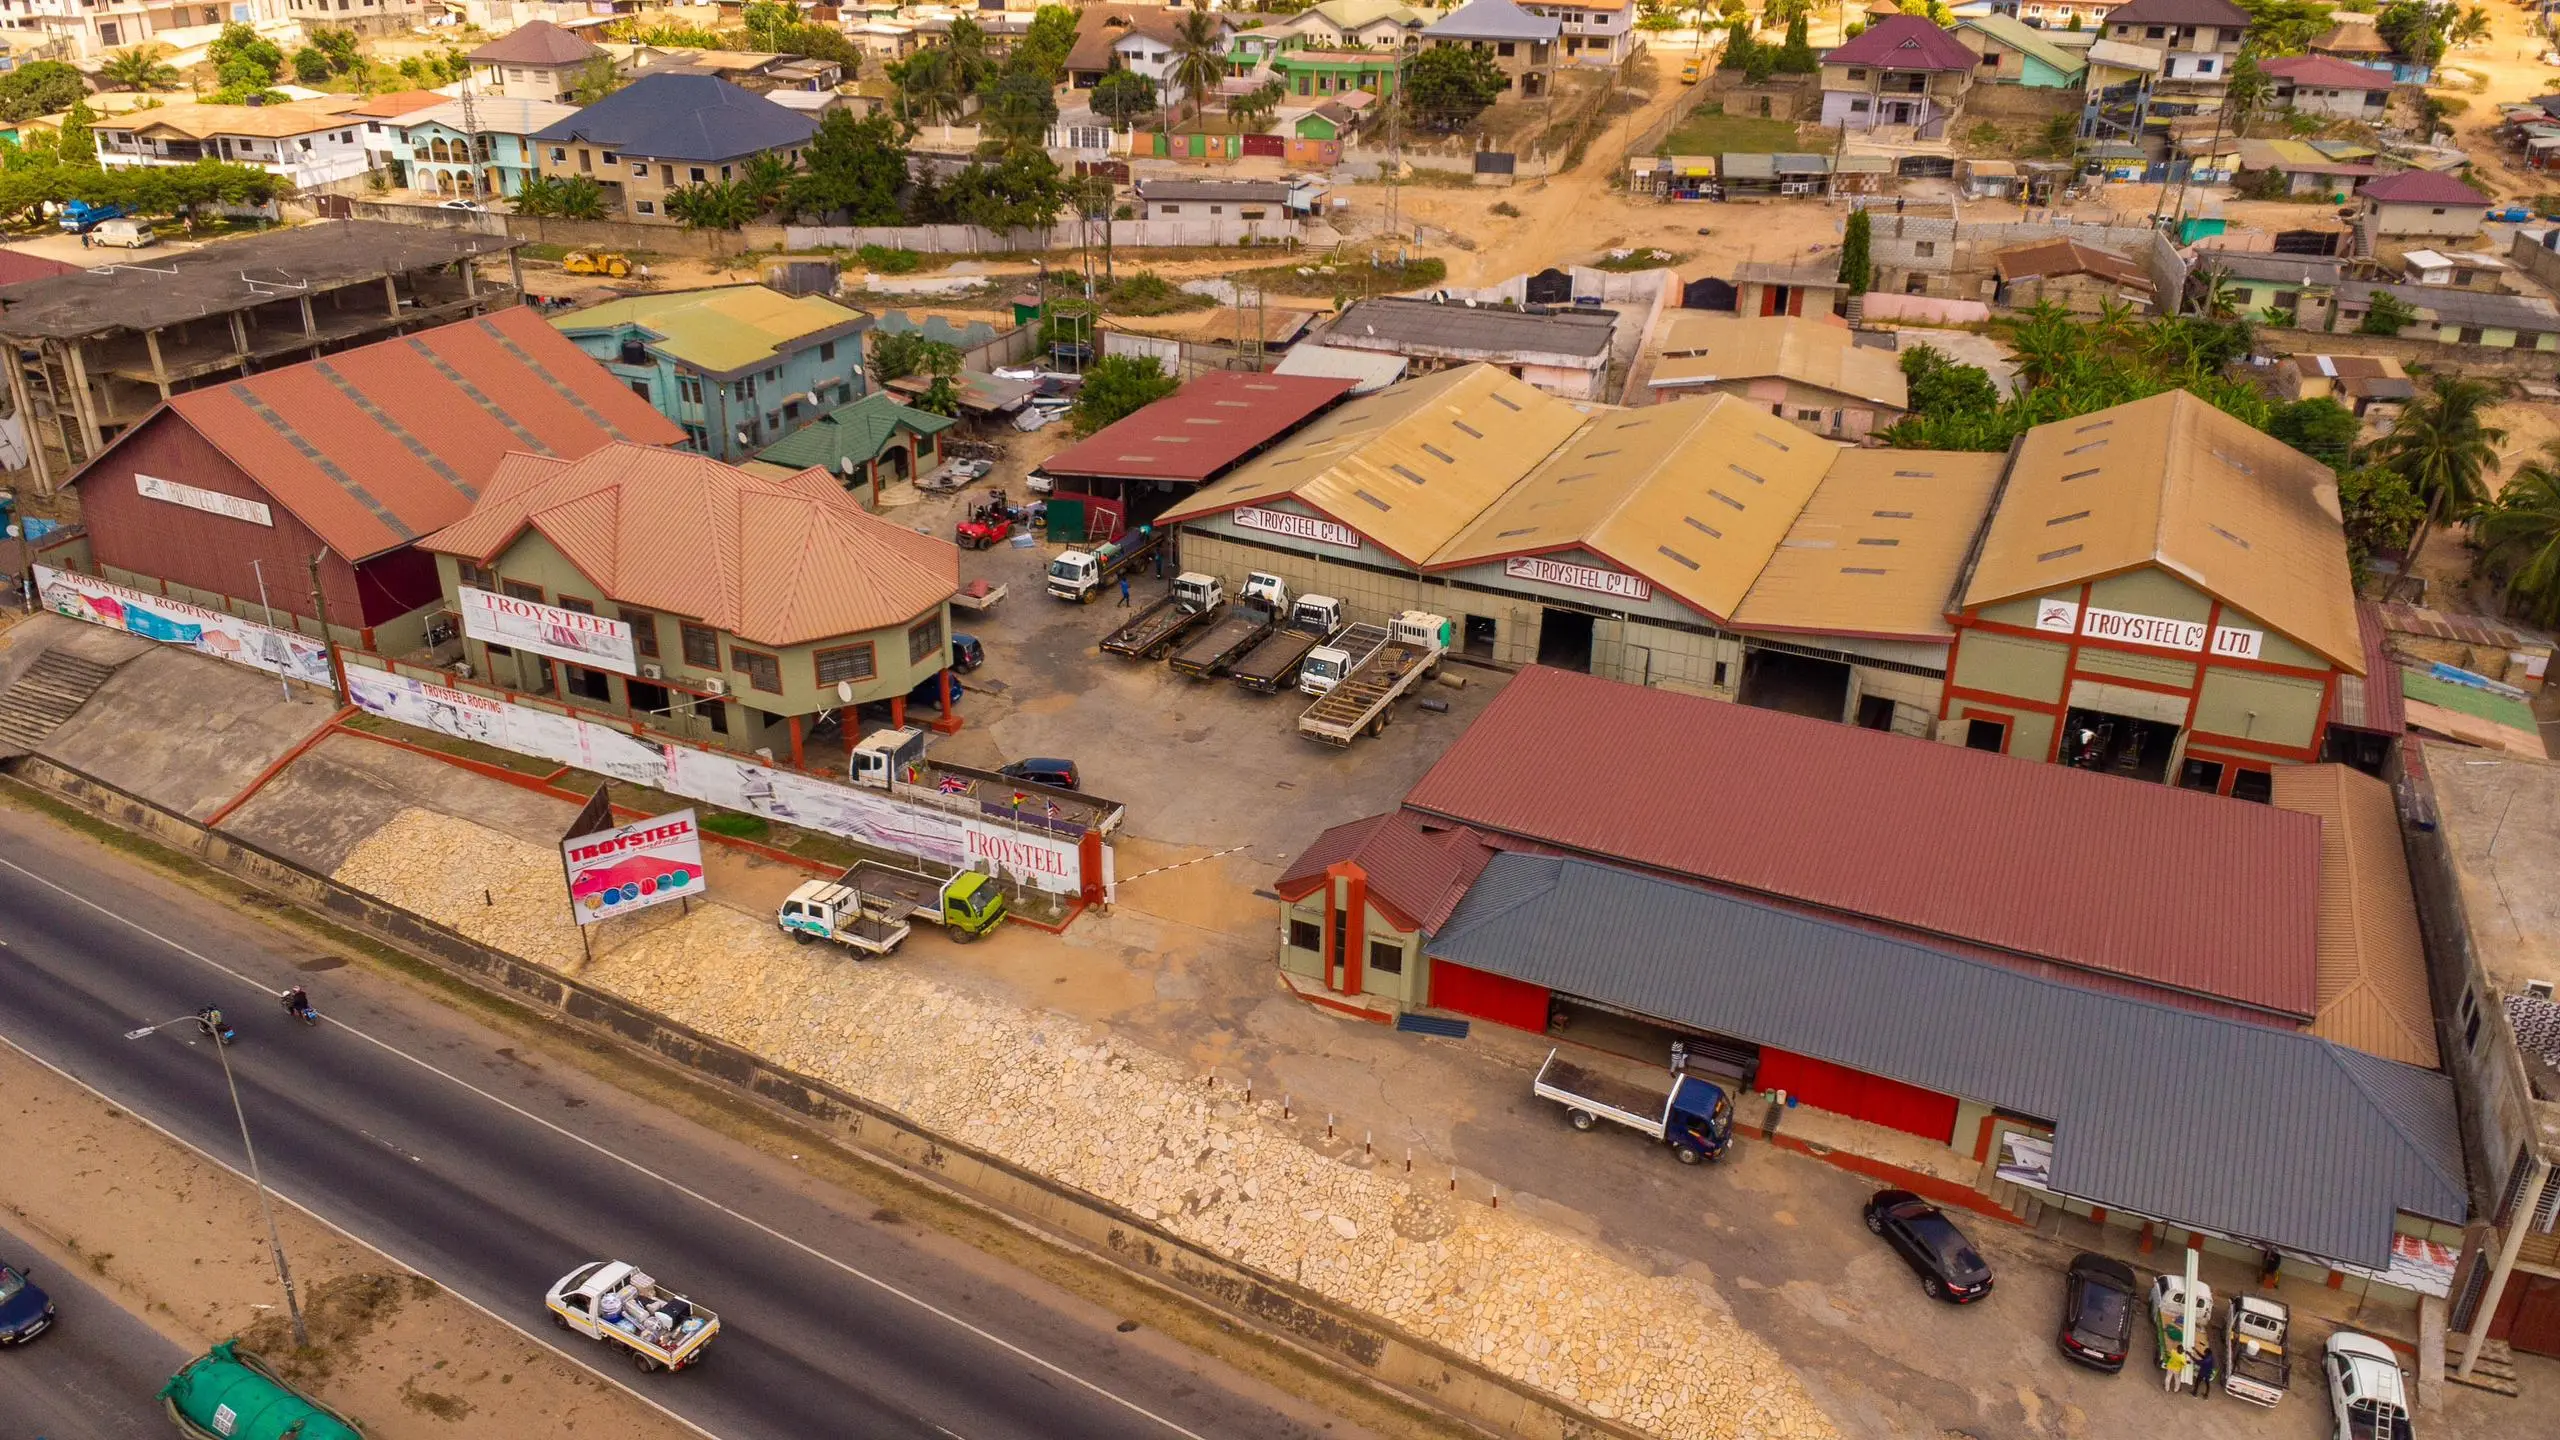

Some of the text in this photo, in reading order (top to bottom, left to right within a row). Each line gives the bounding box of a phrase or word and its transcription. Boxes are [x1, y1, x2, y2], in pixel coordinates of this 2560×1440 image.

[1259, 510, 1317, 537] TROYSTEEL
[1535, 560, 1602, 588] TROYSTEEL
[63, 572, 223, 623] TROYSTEEL ROOFING
[481, 593, 625, 640] TROYSTEEL
[2088, 611, 2181, 645] TROYSTEEL
[2217, 630, 2251, 654] LTD.
[423, 684, 501, 714] TROYSTEEL ROOFING
[567, 820, 693, 862] TROYSTEEL
[966, 829, 1069, 877] TROYSTEEL
